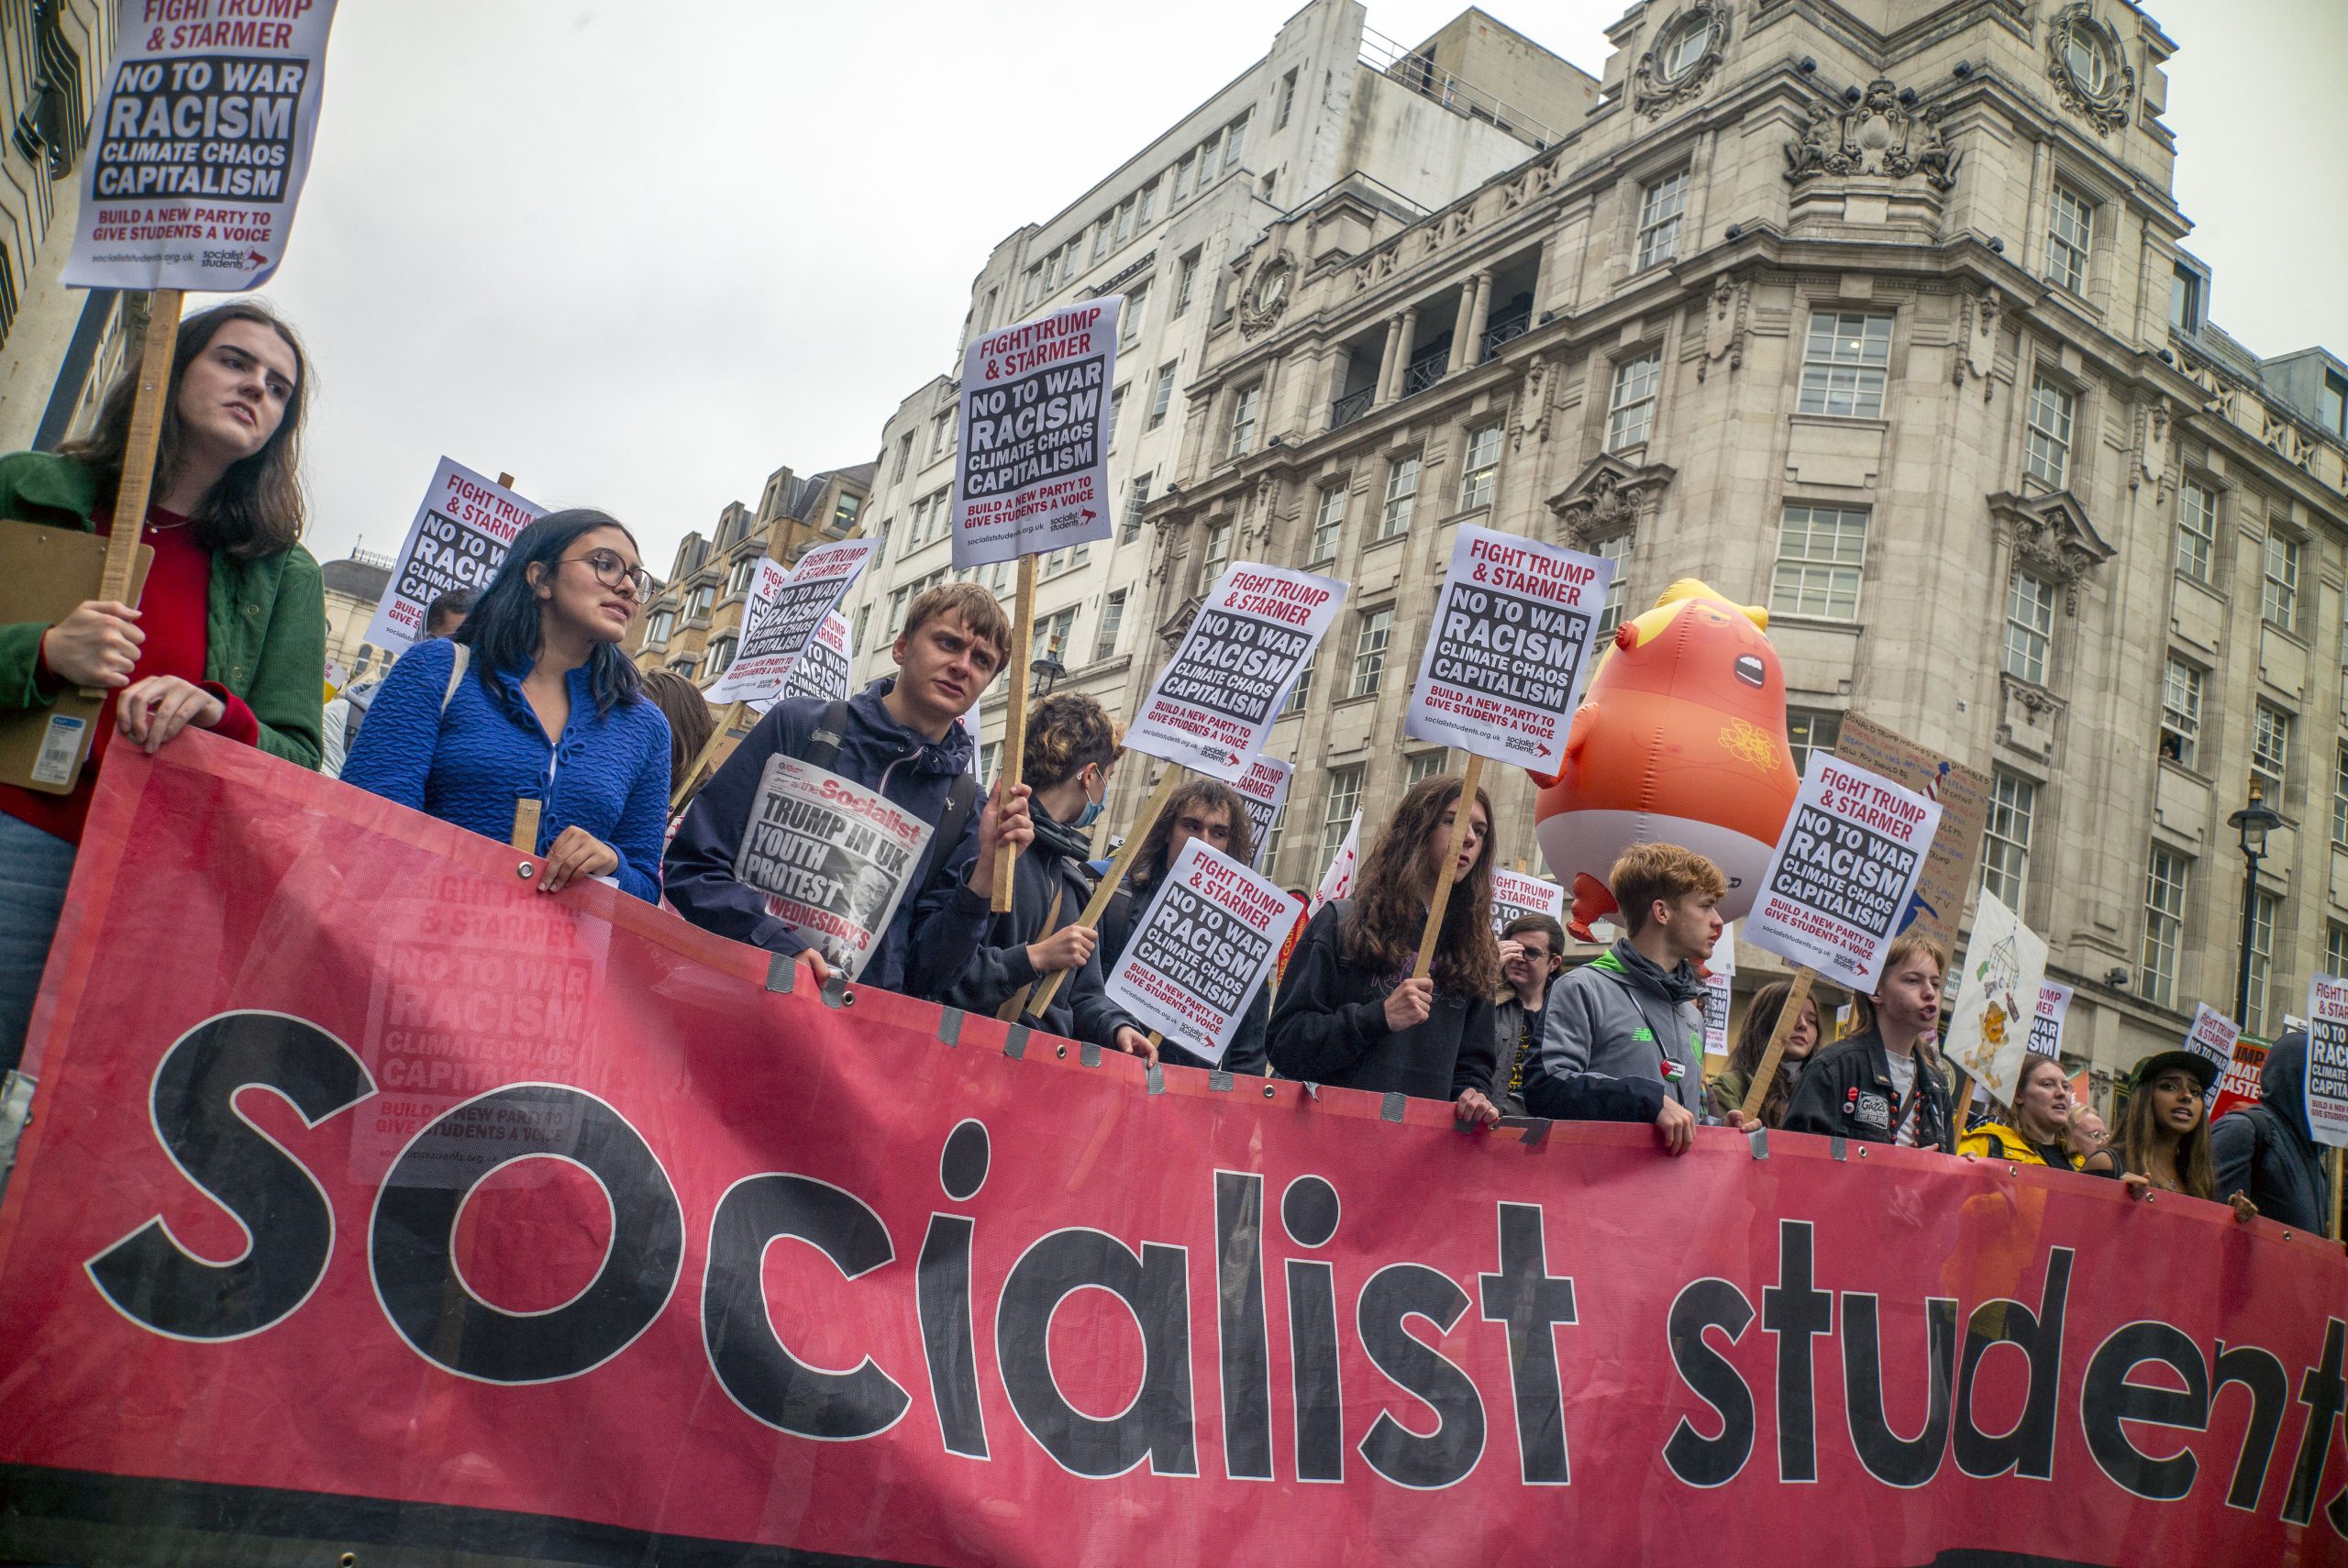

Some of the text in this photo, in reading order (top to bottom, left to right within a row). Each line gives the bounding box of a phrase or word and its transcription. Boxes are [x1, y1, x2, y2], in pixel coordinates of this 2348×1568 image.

[143, 0, 312, 23] FIGHT TRUMP
[146, 21, 293, 51] & STARMER
[116, 61, 303, 93] NO TO WAR
[109, 95, 293, 138] RACISM
[103, 142, 285, 166] CLIMATE CHAOS
[100, 166, 282, 195] CAPITALISM
[93, 225, 271, 242] GIVE STUDENTS A VOICE
[99, 208, 271, 226] BUILD A NEW PARTY TO
[201, 257, 243, 270] students
[203, 249, 244, 261] socialist
[980, 308, 1100, 359] FIGHT TRUMP
[985, 333, 1091, 381] & STARMER
[971, 362, 1102, 418] NO TO WAR
[970, 388, 1098, 452] RACISM
[969, 422, 1092, 471] CLIMATE CHAOS
[968, 440, 1091, 494] CAPITALISM
[447, 474, 495, 509] FIGHT
[965, 489, 1093, 529] GIVE STUDENTS A VOICE
[968, 476, 1091, 516] BUILD A NEW PARTY TO
[423, 514, 485, 557] NO TO
[447, 497, 519, 543] & STARM
[1050, 512, 1078, 525] socialist
[1050, 517, 1079, 532] students
[1470, 539, 1595, 586] FIGHT TRUMP
[774, 581, 843, 606] NO TO WAR
[1229, 572, 1330, 607] FIGHT TRUMP
[1472, 563, 1580, 606] & STARMER
[395, 601, 424, 619] BUILD
[760, 599, 833, 627] RACISM
[1224, 591, 1311, 626] & STARMER
[1451, 587, 1586, 641] NO TO WAR
[743, 634, 807, 657] CAPITALISM
[752, 621, 814, 641] CLIMATE CHAOS
[1199, 613, 1306, 657] NO TO WAR
[1444, 611, 1578, 670] RACISM
[807, 644, 847, 673] TO WAR
[1184, 635, 1294, 683] RACISM
[1440, 641, 1568, 687] CLIMATE CHAOS
[1164, 677, 1266, 719] CAPITALISM
[1175, 662, 1274, 698] CLIMATE CHAOS
[1435, 658, 1565, 708] CAPITALISM
[1425, 696, 1555, 739] GIVE STUDENTS A VOICE
[1431, 685, 1555, 727] BUILD A NEW PARTY TO
[1844, 712, 1876, 734] DONALD
[1424, 716, 1501, 741] socialiststudents.org.uk
[1505, 740, 1534, 755] students
[1507, 736, 1534, 748] socialist
[1253, 763, 1283, 784] TRUMP
[1840, 745, 1856, 756] HOW
[1859, 753, 1871, 763] YOU
[1874, 760, 1898, 774] SHOULD
[801, 780, 819, 795] the
[819, 779, 921, 844] Socialist
[1245, 801, 1272, 823] WAR
[1821, 767, 1926, 823] FIGHT TRUMP
[763, 792, 847, 845] TRUMP
[844, 823, 877, 855] IN
[875, 839, 910, 878] UK
[1820, 790, 1912, 842] & STARMER
[754, 825, 830, 871] YOUTH
[1798, 809, 1913, 874] NO TO WAR
[745, 854, 844, 907] PROTEST
[1192, 851, 1235, 886] FIGHT
[1235, 877, 1285, 916] TRUMP
[1789, 830, 1905, 900] RACISM
[1190, 872, 1202, 889] &
[1203, 880, 1270, 932] STARMER
[1500, 889, 1548, 911] STARMER
[1520, 882, 1555, 900] TRUMP
[1777, 874, 1888, 933] CAPITALISM
[1783, 857, 1893, 914] CLIMATE CHAOS
[768, 898, 870, 950] WEDNESDAY'S
[1166, 886, 1196, 912] NO
[1198, 904, 1223, 929] TO
[1225, 921, 1268, 960] WAR
[1502, 907, 1519, 920] TO
[1147, 928, 1243, 994] CLIMATE CHAOS
[1154, 904, 1257, 982] RACISM
[1139, 942, 1236, 1010] CAPITALISM
[2316, 983, 2342, 1002] FIGHT
[2032, 1018, 2056, 1038] WAR
[2200, 1013, 2235, 1041] FIGHT TRUMP
[2203, 1029, 2230, 1053] STARMER
[2313, 1021, 2346, 1043] NO TO
[2188, 1038, 2200, 1053] NO
[2211, 1054, 2228, 1071] WAR
[2312, 1064, 2346, 1081] CLIMATE
